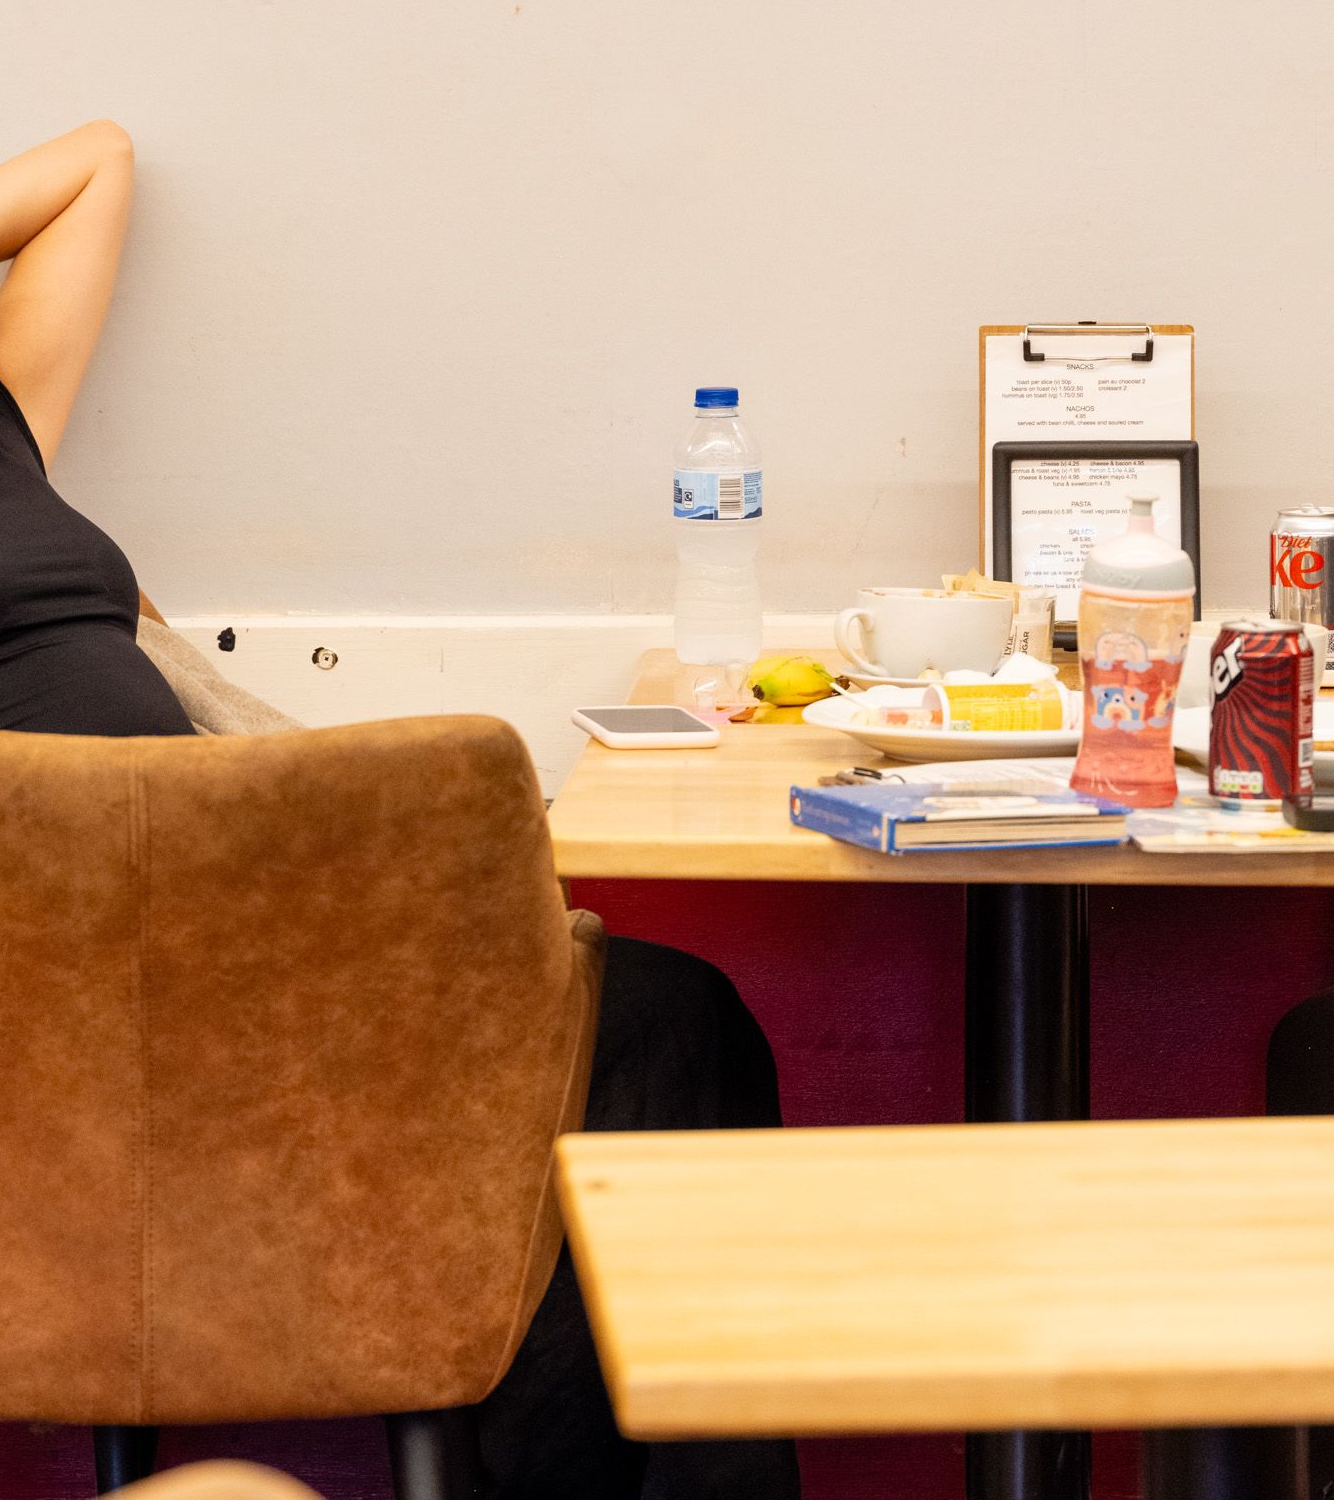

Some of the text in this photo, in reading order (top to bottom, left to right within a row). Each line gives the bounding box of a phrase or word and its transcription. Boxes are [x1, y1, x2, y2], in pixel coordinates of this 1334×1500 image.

[1066, 363, 1095, 371] SNACKS
[1065, 405, 1096, 413] NACHOS
[1070, 500, 1092, 508] PASTA
[1277, 532, 1313, 549] Diet
